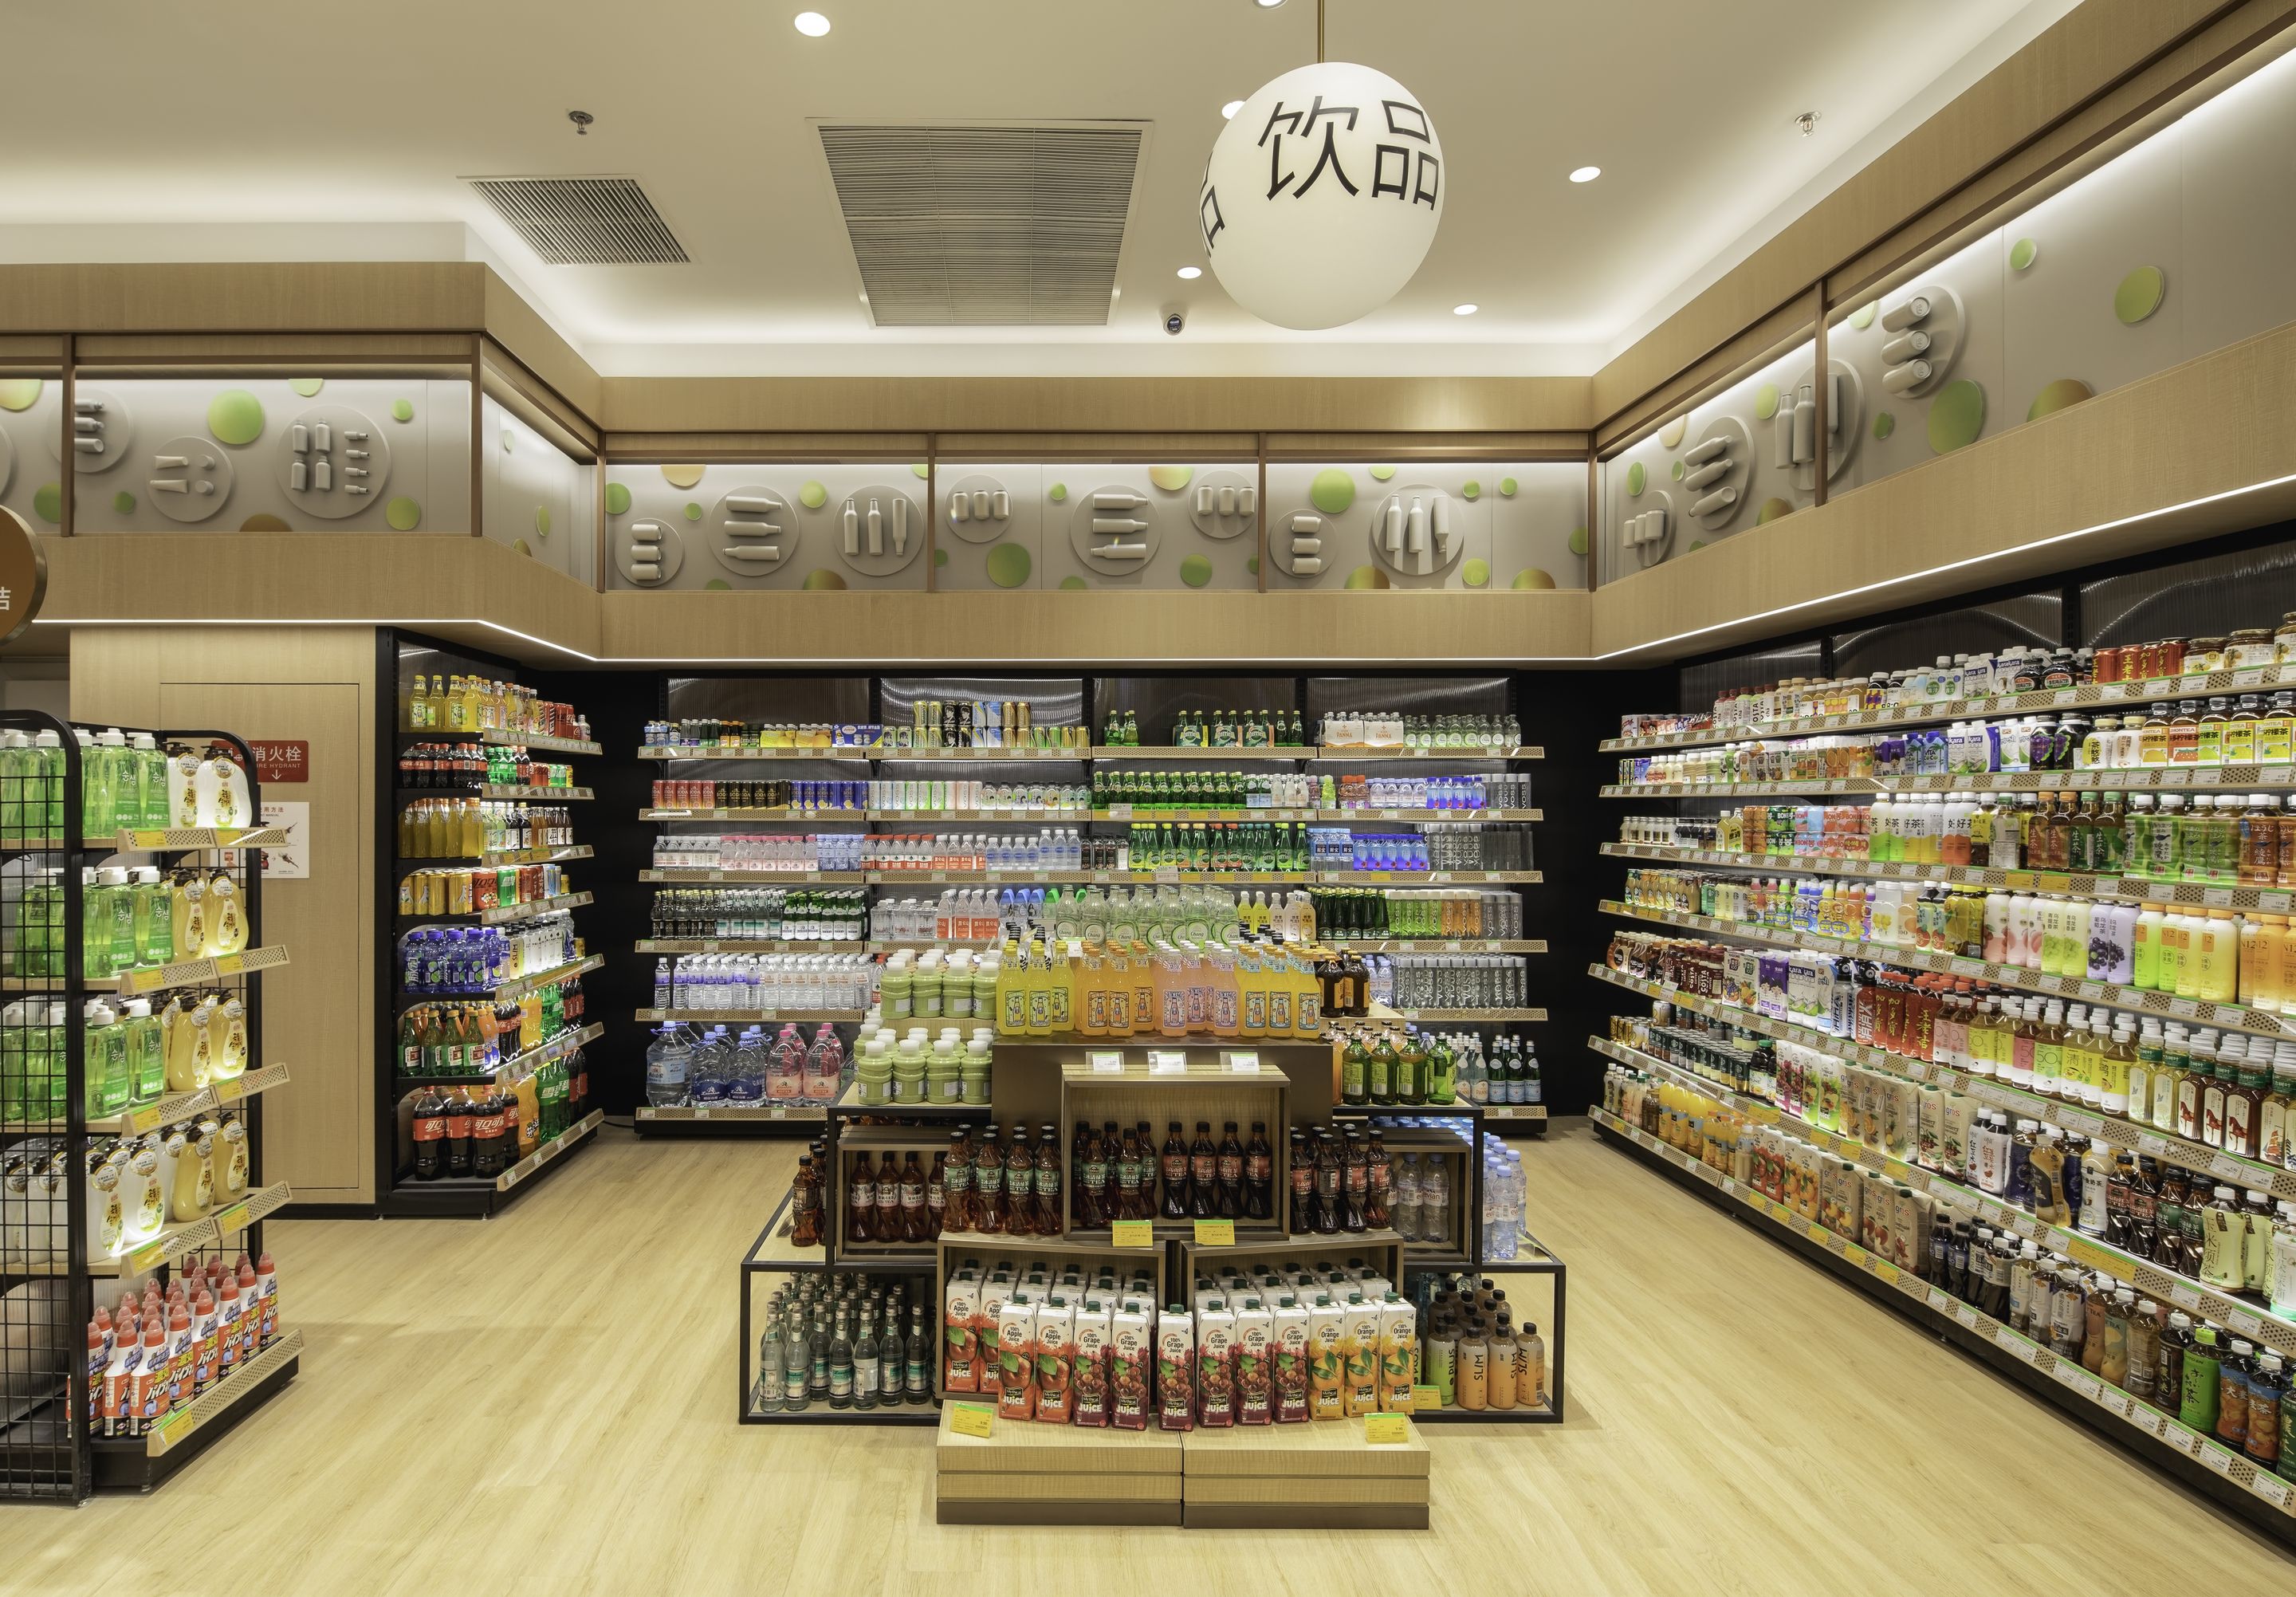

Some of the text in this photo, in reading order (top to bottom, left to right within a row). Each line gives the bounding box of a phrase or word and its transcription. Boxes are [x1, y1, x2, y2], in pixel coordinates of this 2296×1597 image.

[1257, 96, 1439, 210] 饮品
[252, 745, 301, 762] 消火栓
[2071, 831, 2082, 853] 生茶
[2095, 831, 2105, 855] 生茶
[1917, 1009, 1932, 1049] 王老吉
[474, 1116, 504, 1130] 可口可乐
[1945, 1107, 1960, 1117] gros
[425, 1119, 446, 1132] 可口
[1473, 1355, 1484, 1381] SLIM
[1518, 1347, 1528, 1375] SLIM
